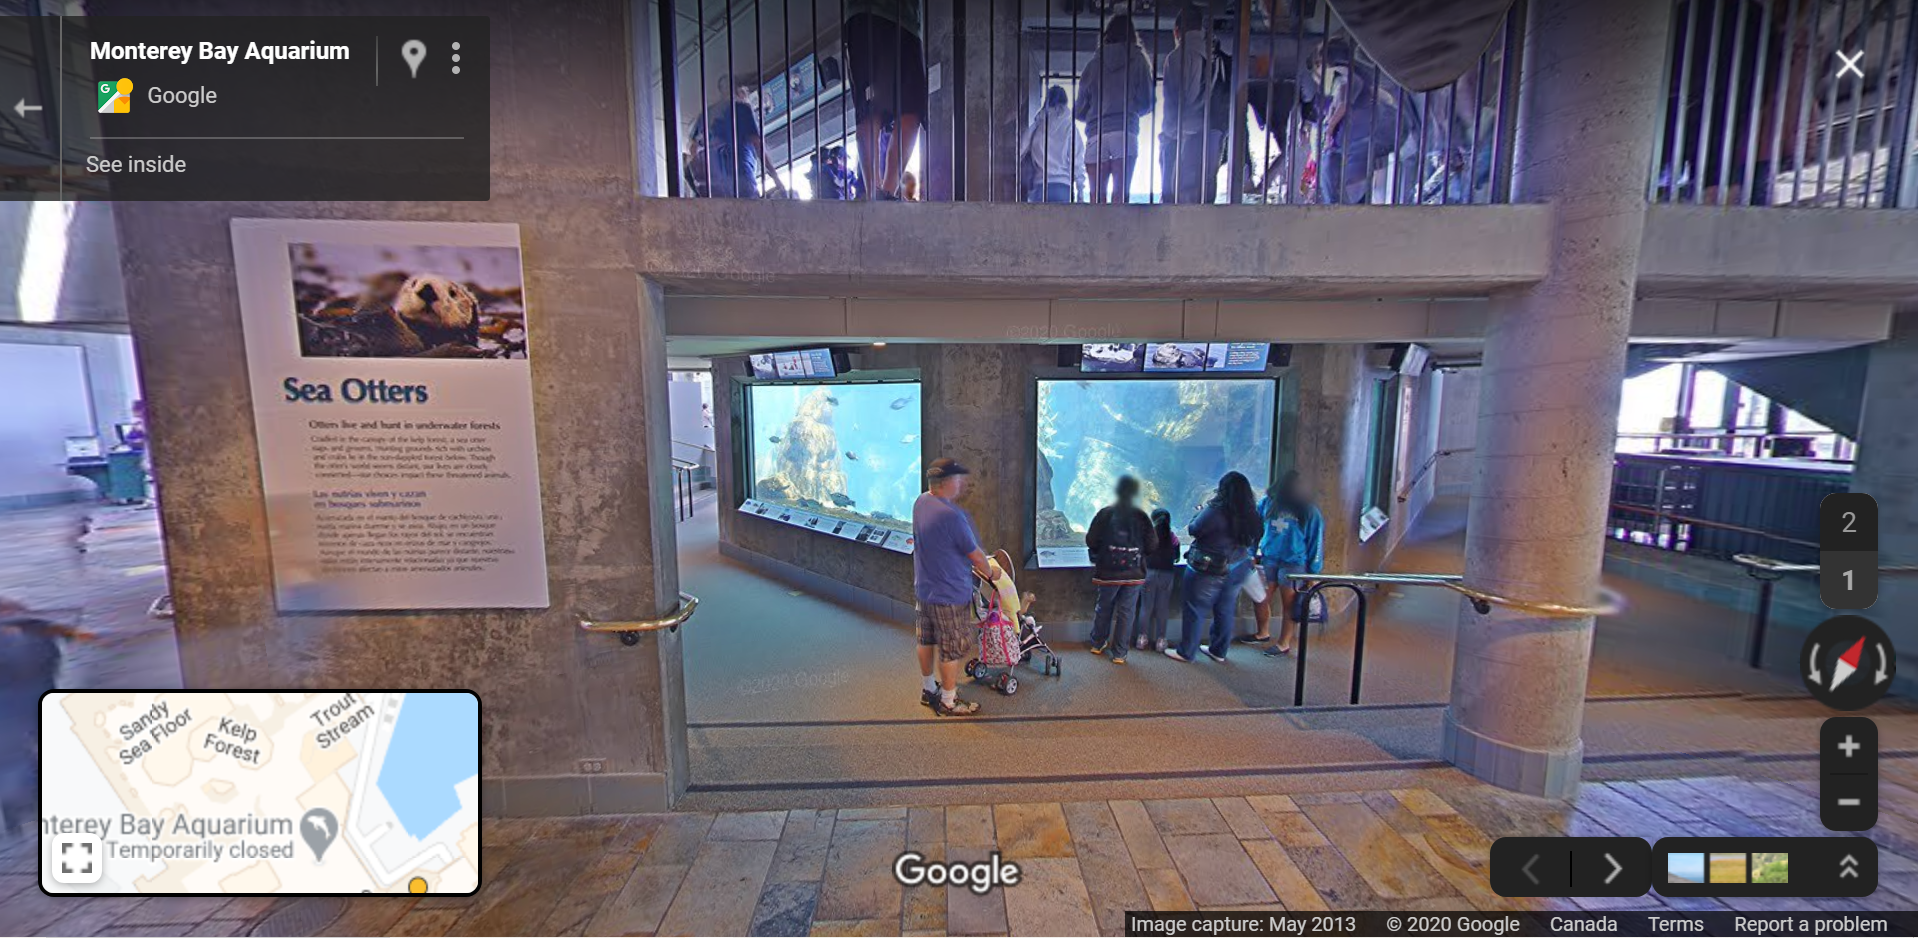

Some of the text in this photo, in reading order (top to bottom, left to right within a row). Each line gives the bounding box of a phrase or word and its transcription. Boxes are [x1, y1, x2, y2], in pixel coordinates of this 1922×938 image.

[283, 377, 428, 405] Sea Otters
[309, 420, 339, 429] Otters
[342, 420, 357, 429] live
[360, 420, 377, 429] and
[381, 420, 401, 429] hunt
[416, 420, 468, 429] underwater
[470, 420, 501, 429] forests
